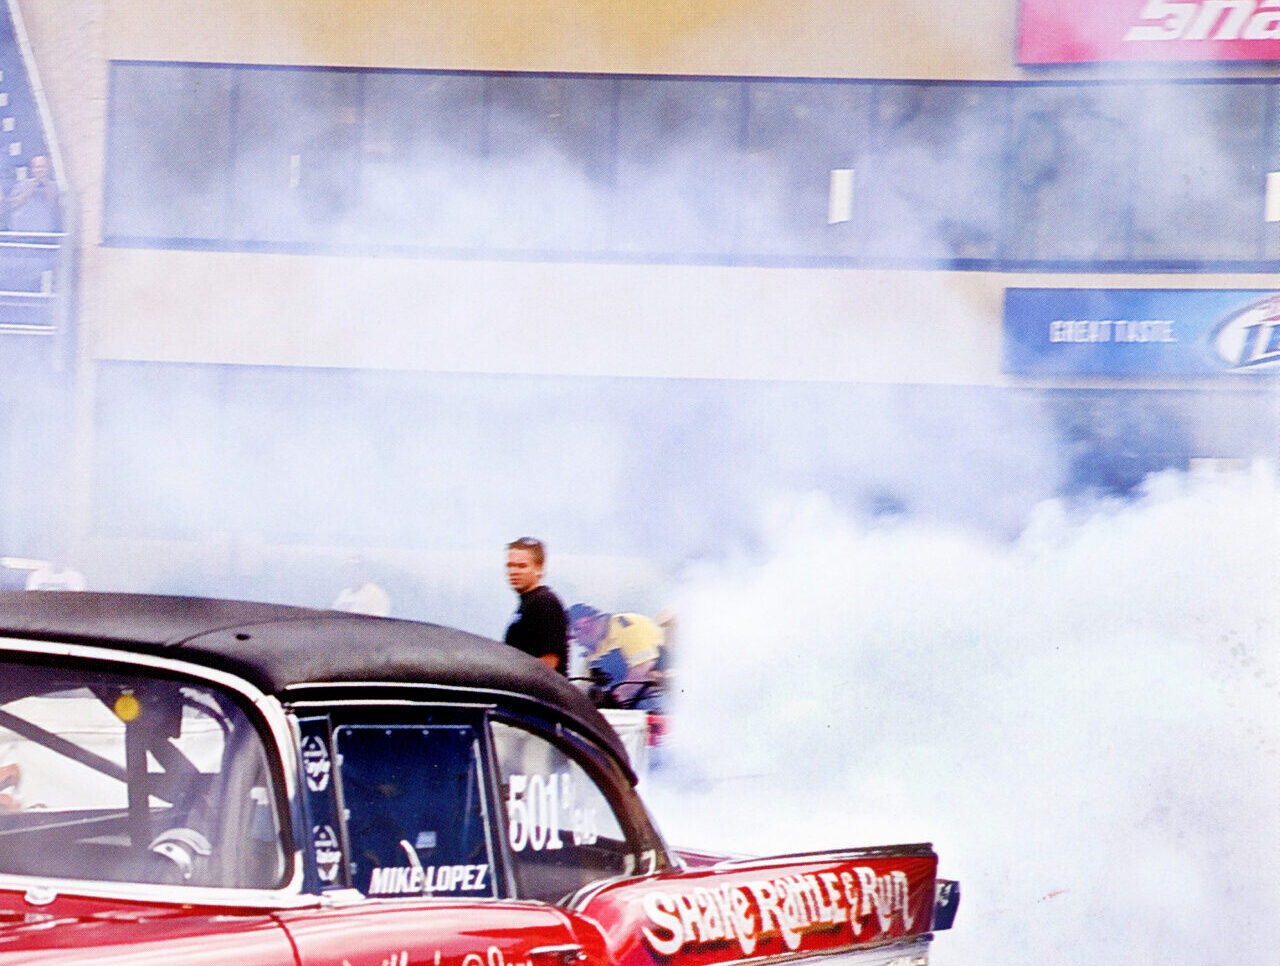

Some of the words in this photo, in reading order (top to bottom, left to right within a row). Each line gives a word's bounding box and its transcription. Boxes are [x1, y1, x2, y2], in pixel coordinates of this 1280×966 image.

[1049, 320, 1111, 343] GREAT
[505, 773, 563, 852] 501
[369, 866, 421, 895] MIKE
[422, 864, 489, 892] LOPEZ
